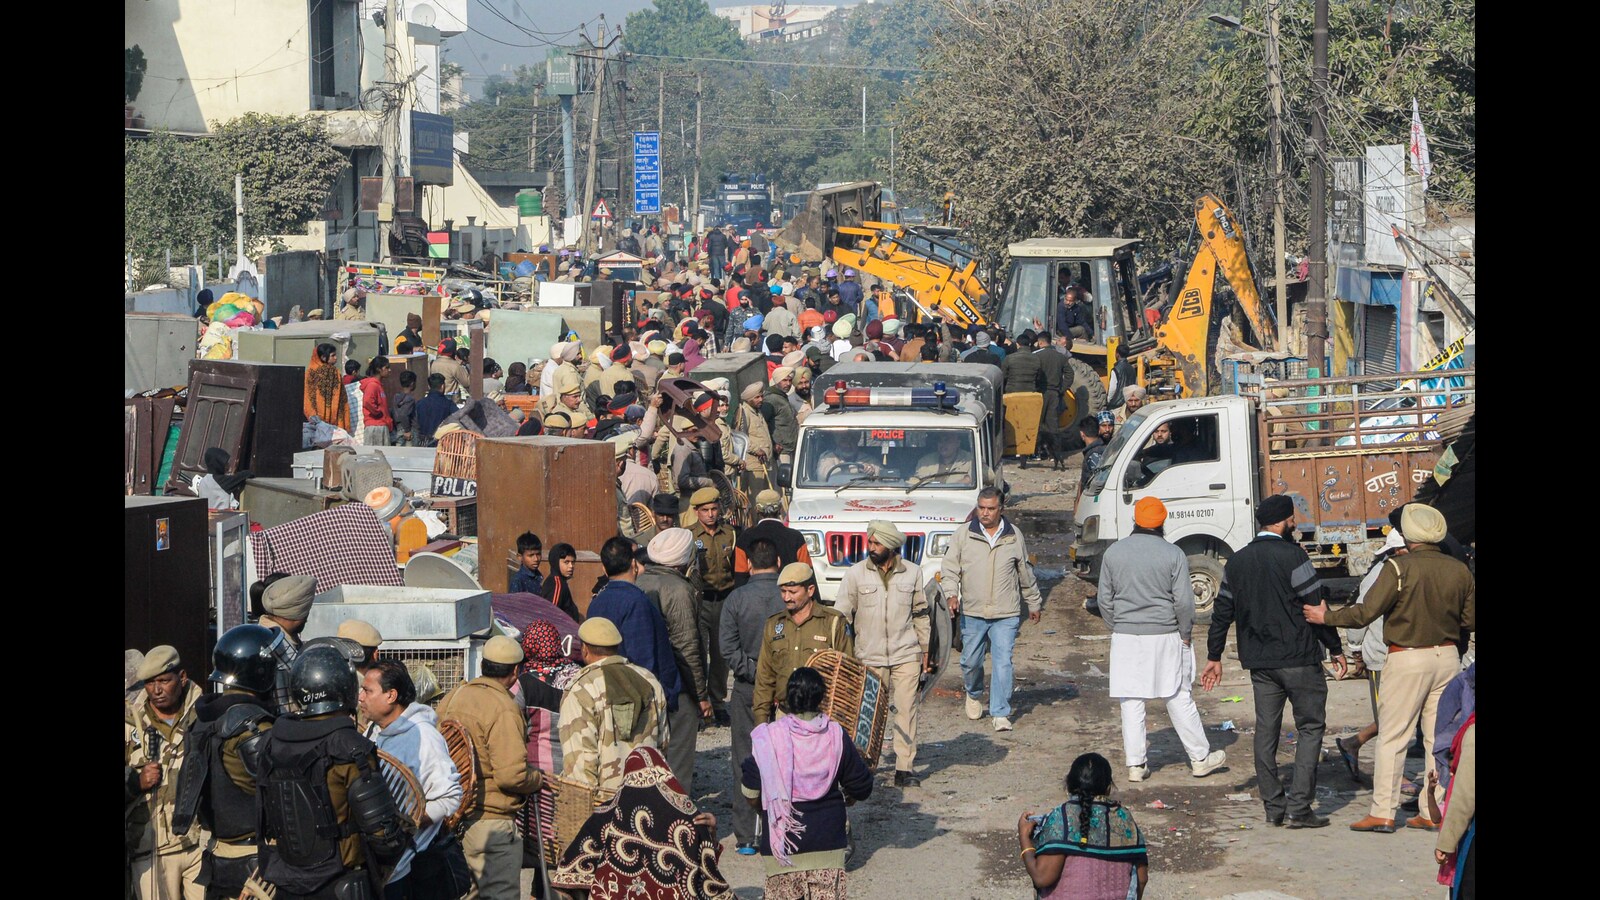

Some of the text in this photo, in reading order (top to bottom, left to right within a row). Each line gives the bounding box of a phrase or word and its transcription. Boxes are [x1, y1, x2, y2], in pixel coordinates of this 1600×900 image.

[1181, 290, 1202, 315] JCB
[960, 304, 977, 322] 3DX
[871, 430, 905, 439] POLICE
[433, 476, 477, 497] POLIC
[1168, 508, 1214, 520] M.98144 02107
[856, 673, 880, 748] POLICE
